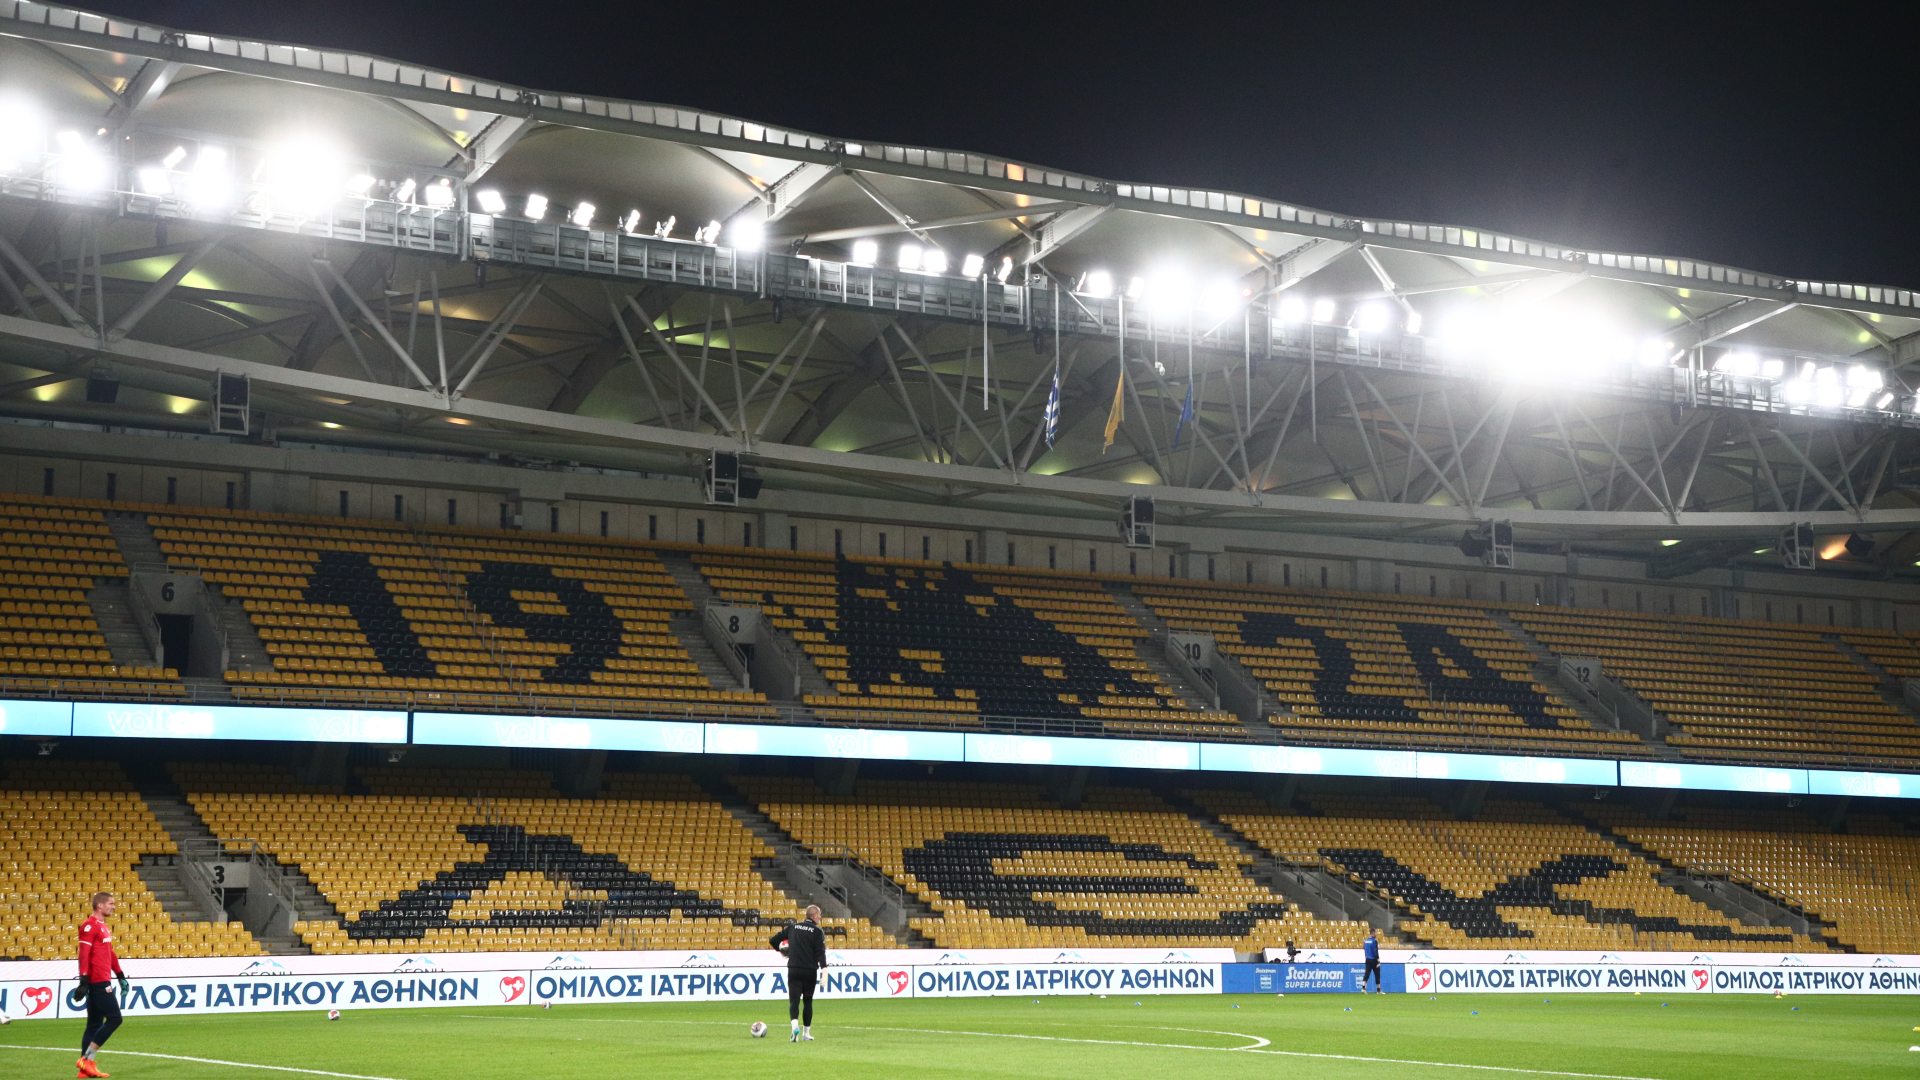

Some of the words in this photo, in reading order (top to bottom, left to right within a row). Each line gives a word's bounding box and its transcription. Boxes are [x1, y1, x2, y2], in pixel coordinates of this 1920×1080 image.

[161, 582, 175, 602] 6
[729, 615, 740, 634] 8
[1184, 642, 1201, 661] 10
[1576, 666, 1591, 683] 12
[212, 865, 224, 884] 3
[918, 971, 1009, 992] ΟΜΙΛΟΣ
[1017, 969, 1114, 989] ΙΑΤΡΙΚΟΥ
[1120, 969, 1214, 988] ΑΘΗΝΩΝ
[1286, 966, 1344, 980] Stoiximan
[1439, 969, 1515, 987] ΟΜΙΛΟΣ
[1520, 969, 1602, 987] ΙΑΤΡΙΚΟΥ
[1608, 969, 1686, 987] ΑΘΗΝΩΝ
[1716, 971, 1785, 989] ΟΜΙΛΟΣ
[1789, 972, 1865, 989] ΙΑΤΡΙΚΟΥ
[1869, 972, 1920, 989] ΑΘΗΝ
[536, 975, 642, 998] ΟΜΙΛΟΣ
[651, 973, 764, 995] ΙΑΤΡΙΚΟΥ
[771, 972, 877, 993] ΑΝΩΝ
[1284, 981, 1310, 989] SUPER
[1311, 981, 1343, 989] LEAGUE
[66, 985, 196, 1012] ΟΙΛΟΣ
[206, 981, 343, 1007] ΙΑΤΡΙΚΟΥ
[350, 978, 478, 1003] ΑΘΗΝΩΝ
